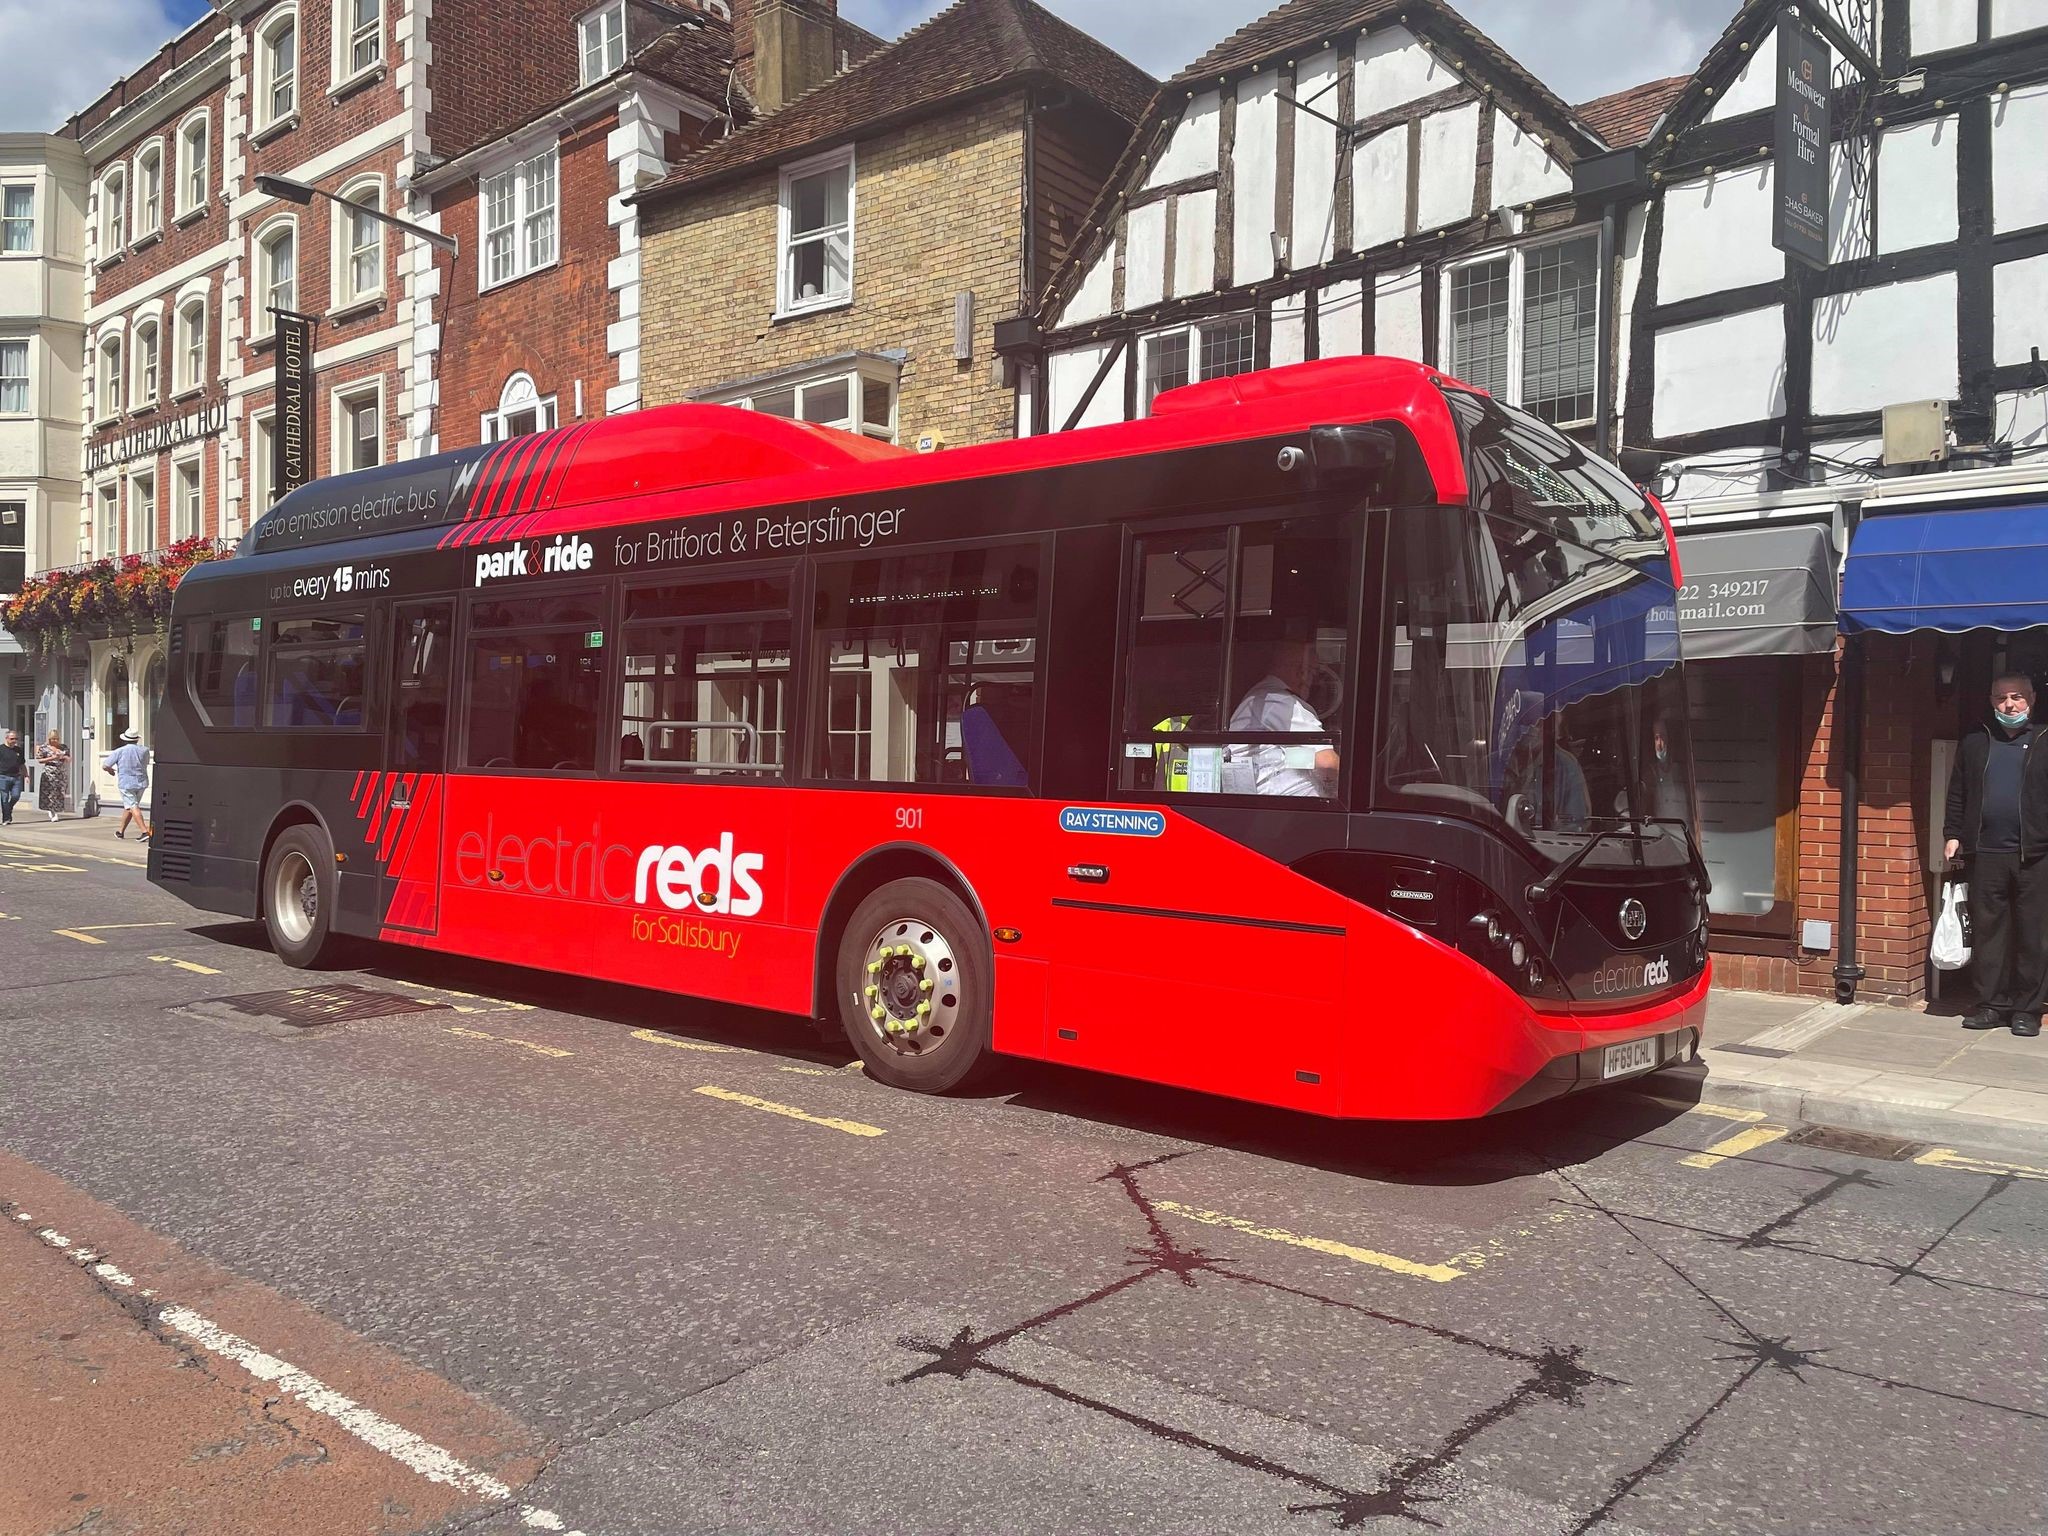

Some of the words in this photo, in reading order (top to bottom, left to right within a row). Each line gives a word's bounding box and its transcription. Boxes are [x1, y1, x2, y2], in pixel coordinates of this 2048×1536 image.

[1787, 66, 1826, 110] Menswear
[1792, 112, 1820, 147] Formal
[1797, 138, 1815, 165] Hire
[286, 327, 302, 381] HOTEL
[84, 438, 107, 470] THE
[110, 408, 193, 463] CATHEDRAL
[286, 383, 302, 479] CATHEDRAL
[259, 516, 286, 539] zero
[288, 502, 348, 534] emission
[351, 489, 404, 523] electric
[407, 486, 437, 513] bus
[615, 535, 642, 566] for
[647, 522, 722, 562] Britford
[730, 520, 747, 553] &
[755, 506, 906, 549] Petersfinger
[293, 574, 331, 600] every
[332, 565, 354, 593] 15
[355, 563, 391, 591] mins
[1707, 580, 1770, 599] 349217
[896, 808, 922, 829] 901
[1066, 812, 1091, 828] RAY
[1091, 813, 1159, 831] STENNING
[632, 913, 657, 942] for
[657, 915, 744, 959] Salisbury
[1608, 1045, 1633, 1073] HF69
[1634, 1041, 1652, 1066] CHL
